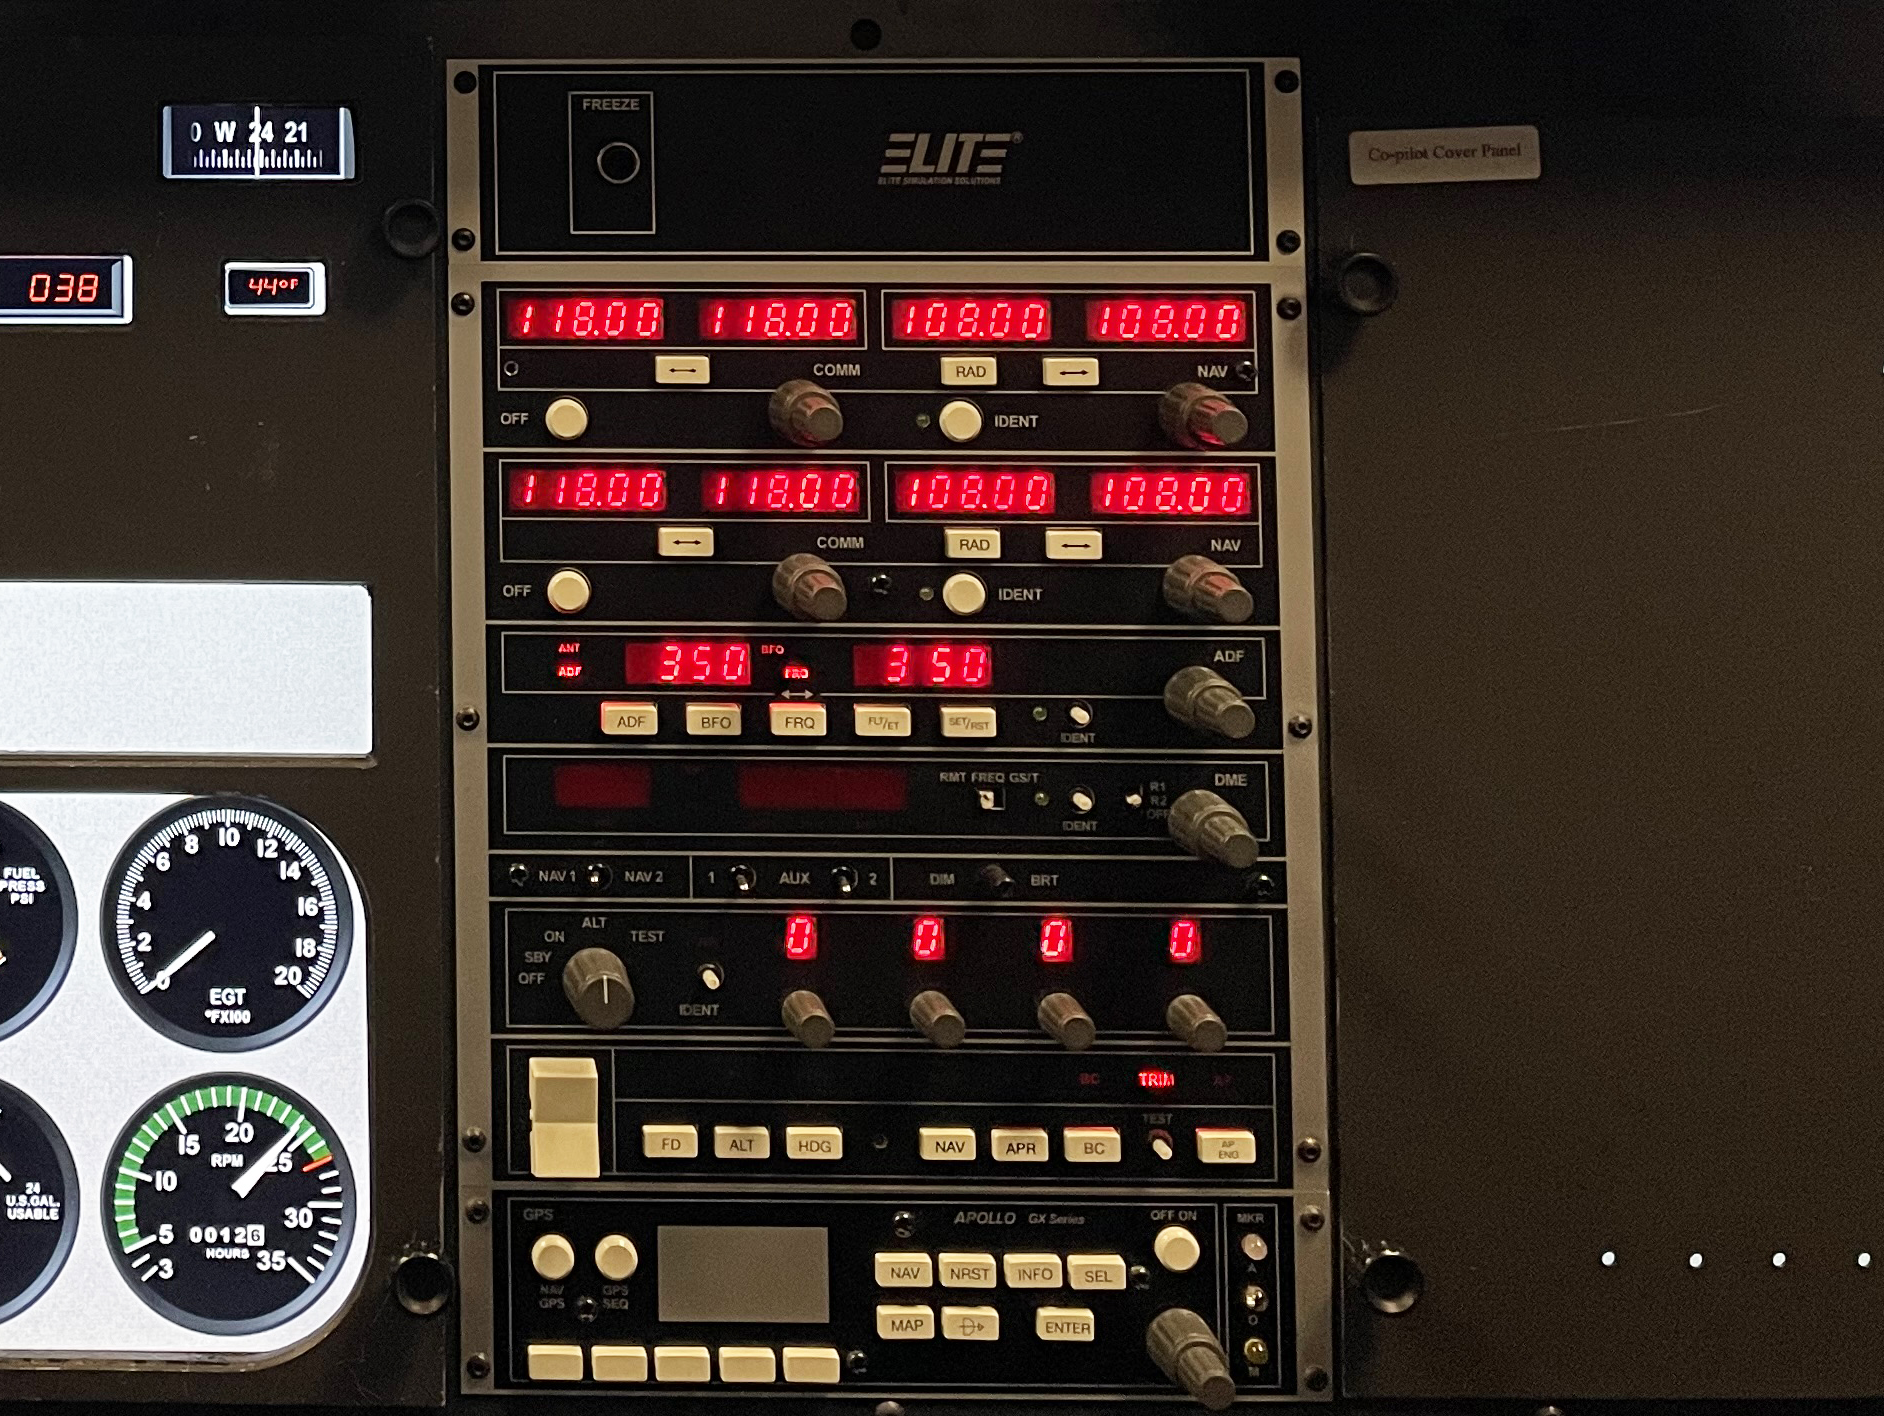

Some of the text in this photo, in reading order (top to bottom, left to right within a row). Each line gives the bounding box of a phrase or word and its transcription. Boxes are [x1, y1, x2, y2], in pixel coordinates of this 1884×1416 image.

[582, 98, 640, 111] FREEZE
[214, 121, 308, 143] W 24 21
[880, 133, 1012, 173] ELITE
[1369, 143, 1521, 164] Co-pilot Cover Panel
[29, 273, 98, 302] 038
[523, 302, 660, 337] 118.00
[714, 303, 853, 337] 118.00
[906, 303, 1045, 338] 108.00
[1100, 304, 1239, 339] 108.00
[814, 364, 860, 376] COMM
[956, 366, 986, 378] RAD
[1197, 366, 1228, 377] NAV
[501, 413, 529, 425] OFF
[995, 416, 1038, 428] IDENT
[524, 473, 663, 507] 118.00
[717, 474, 855, 509] 118.00
[911, 475, 1050, 511] 108.00
[1104, 477, 1243, 512] 108.00
[817, 537, 864, 549] COMM
[960, 539, 990, 551] RAD
[1211, 539, 1241, 552] NAV
[503, 585, 531, 597] OFF
[999, 589, 1043, 601] IDENT
[559, 643, 580, 654] ANT
[1214, 649, 1244, 663] ADF
[558, 667, 582, 677] ADF
[618, 716, 646, 728] ADF
[701, 716, 732, 729] BFO
[785, 717, 815, 730] FRQ
[1061, 733, 1095, 743] IDENT
[940, 772, 1039, 783] RMT FREQ GS/T
[1214, 773, 1247, 786] DME
[1063, 821, 1097, 831] IDENT
[219, 828, 240, 846] 10
[257, 839, 278, 858] 12
[4, 867, 40, 880] FUEL
[280, 861, 301, 880] 14
[539, 870, 576, 882] NAV 1
[625, 870, 663, 882] NAV 2
[780, 871, 810, 884] AUX
[930, 873, 954, 884] DIM
[1031, 875, 1058, 886] BRT
[0, 880, 46, 892] PRESS
[11, 893, 34, 904] PSI
[298, 897, 318, 916] 16
[582, 917, 607, 928] ALT
[545, 931, 564, 942] ON
[631, 931, 664, 942] TEST
[295, 938, 316, 958] 18
[525, 952, 552, 963] SBY
[274, 966, 302, 985] 20
[518, 972, 545, 985] OFF
[210, 988, 246, 1006] EGT
[680, 1004, 719, 1016] IDENT
[1139, 1073, 1174, 1087] TRIM
[225, 1122, 254, 1143] 20
[178, 1135, 200, 1155] 15
[662, 1138, 680, 1150] FD
[730, 1140, 754, 1152] ALT
[798, 1140, 832, 1153] HDG
[935, 1141, 965, 1153] NAV
[1006, 1143, 1036, 1155] APR
[1084, 1143, 1105, 1155] BC
[211, 1154, 243, 1167] RPM
[155, 1171, 177, 1191] 10
[7, 1208, 59, 1220] USABLE
[284, 1208, 313, 1228] 30
[523, 1209, 554, 1220] GPS
[954, 1212, 1084, 1225] APOLLO GX Series
[1151, 1210, 1197, 1221] OFF ON
[206, 1249, 250, 1259] HOURS
[257, 1251, 285, 1271] 35
[890, 1267, 920, 1280] NAV
[950, 1268, 989, 1281] NRST
[1018, 1269, 1053, 1282] INFO
[1085, 1271, 1112, 1283] SEL
[539, 1298, 565, 1309] GPS
[603, 1298, 628, 1310] SEQ
[891, 1319, 923, 1332] MAP
[1046, 1322, 1091, 1335] ENTER
